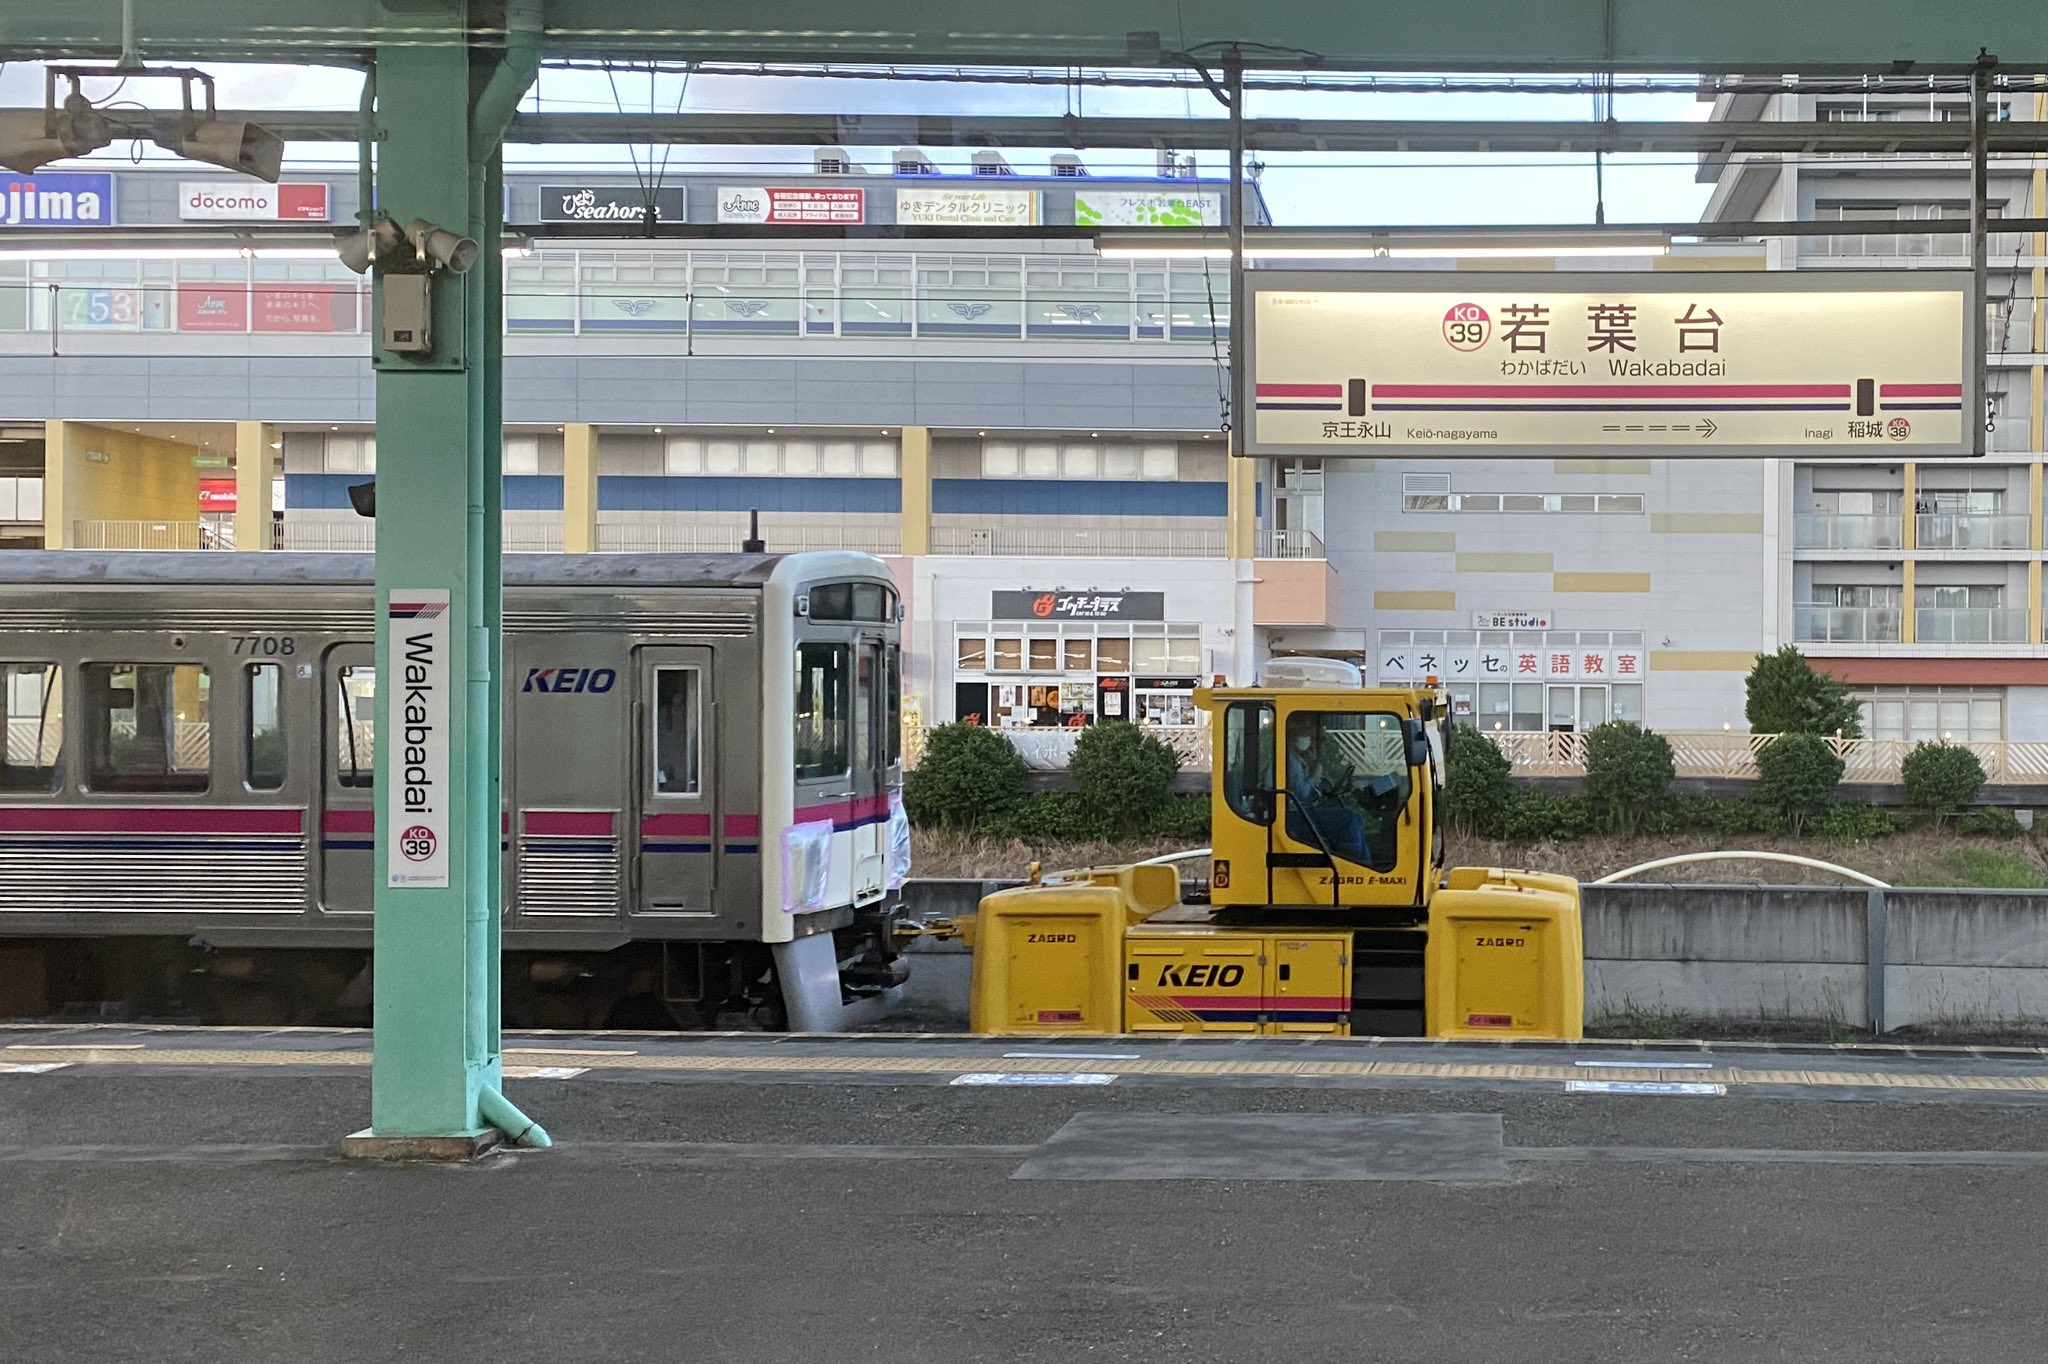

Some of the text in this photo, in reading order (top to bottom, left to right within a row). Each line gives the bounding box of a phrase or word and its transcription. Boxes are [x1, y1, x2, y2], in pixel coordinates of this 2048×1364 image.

[0, 183, 99, 224] jima
[190, 192, 267, 208] docomo
[723, 194, 760, 212] Anne
[900, 200, 1027, 213] ゆきデンタルクリニック
[1455, 307, 1479, 321] KO
[1450, 323, 1483, 343] 39
[1500, 303, 1724, 353] 若葉台
[1501, 360, 1586, 376] わかばだい
[1608, 359, 1727, 376] Wakabadai
[1322, 421, 1391, 439] 京王永山
[1805, 428, 1833, 439] Inagi
[1848, 421, 1883, 438] 稲城
[1890, 427, 1907, 437] 38
[1492, 617, 1506, 626] BE
[1508, 617, 1547, 627] studio
[231, 637, 295, 655] 7708
[1386, 654, 1637, 674] ベネッセの英語教室
[521, 668, 616, 693] KEIO
[405, 633, 433, 813] Wakabadai
[409, 829, 428, 839] KO
[405, 840, 430, 855] 39
[1028, 934, 1077, 943] ZAGRO
[1475, 938, 1525, 947] ZAGRO
[1158, 964, 1245, 987] KEIO
